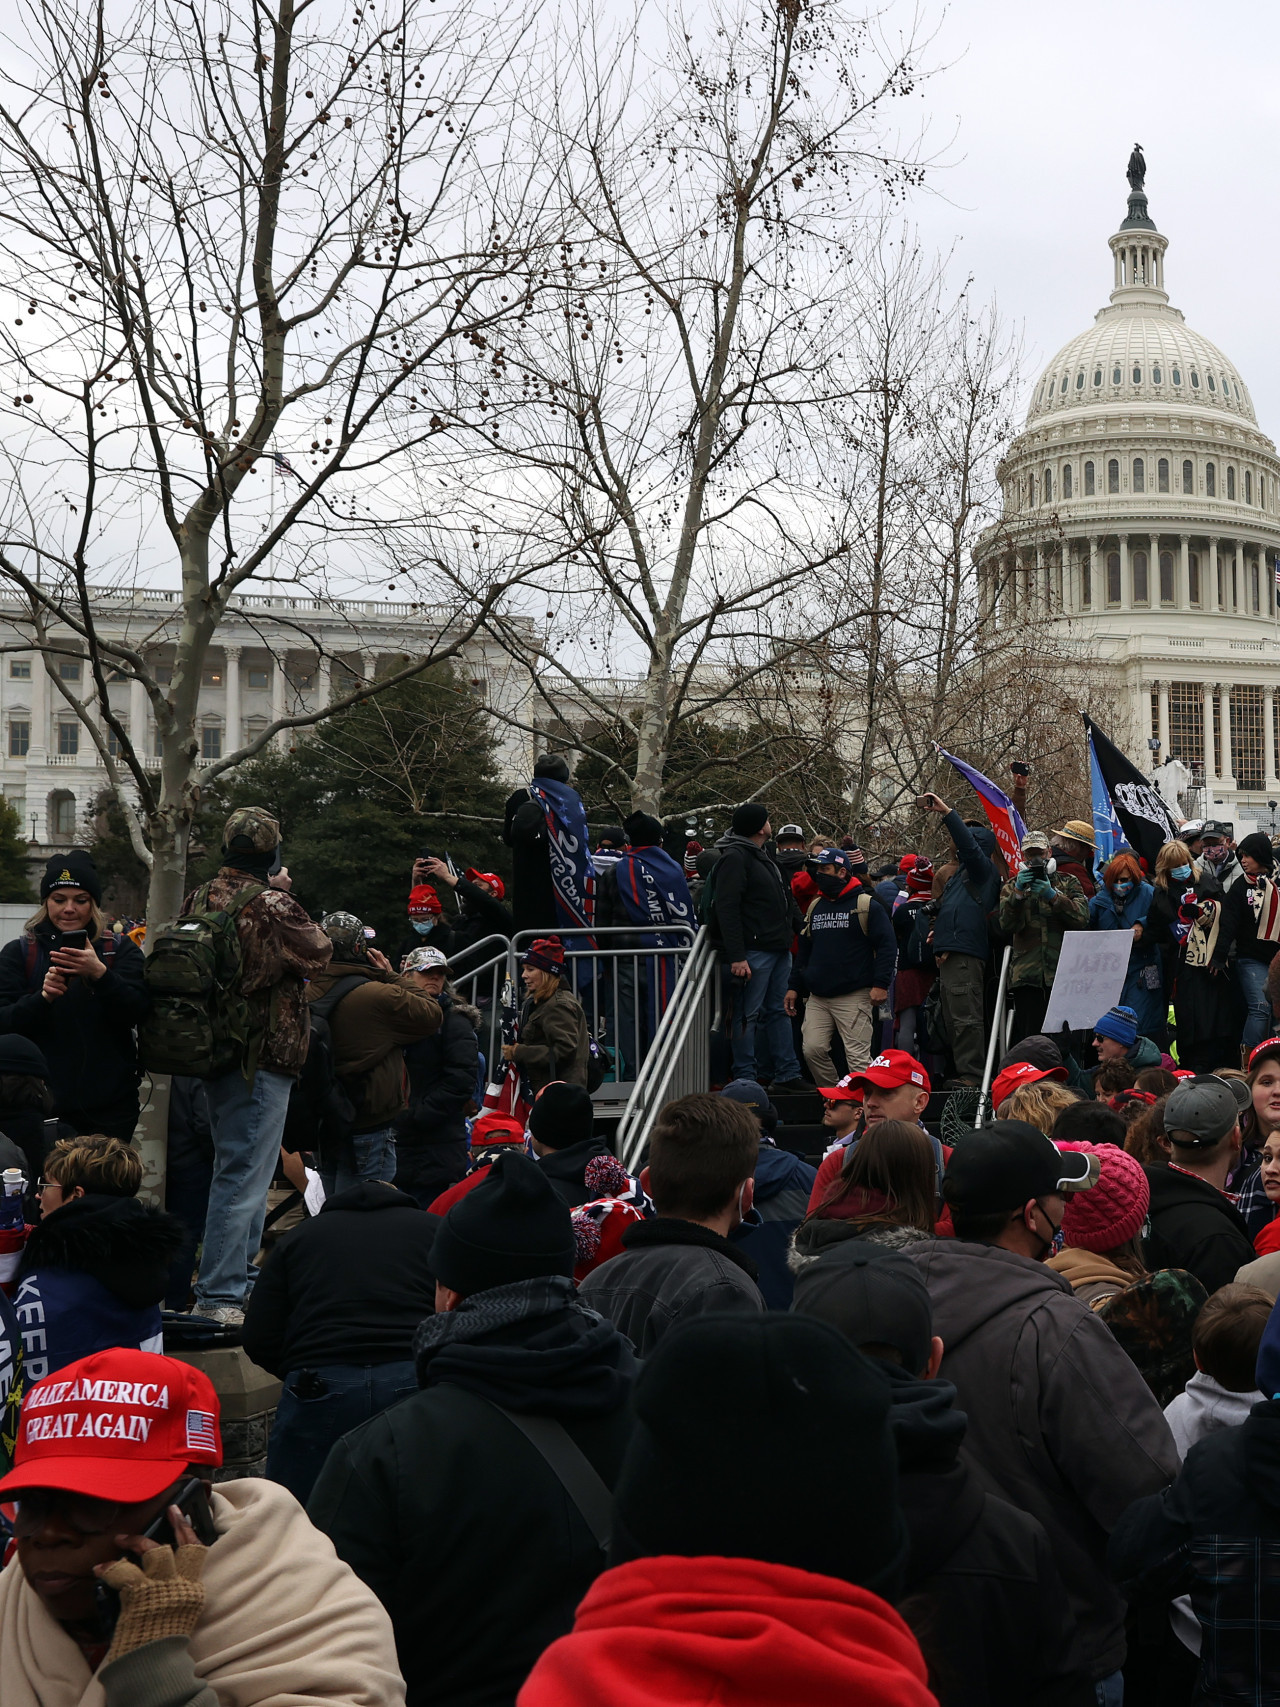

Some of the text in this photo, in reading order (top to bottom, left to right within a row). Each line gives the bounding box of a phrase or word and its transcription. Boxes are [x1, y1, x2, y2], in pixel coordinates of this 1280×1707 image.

[811, 920, 849, 931] DISTANCING
[813, 912, 849, 923] SOCIALISM
[24, 1378, 170, 1412] MAKE AMERICA
[26, 1412, 153, 1445] GREAT AGAIN
